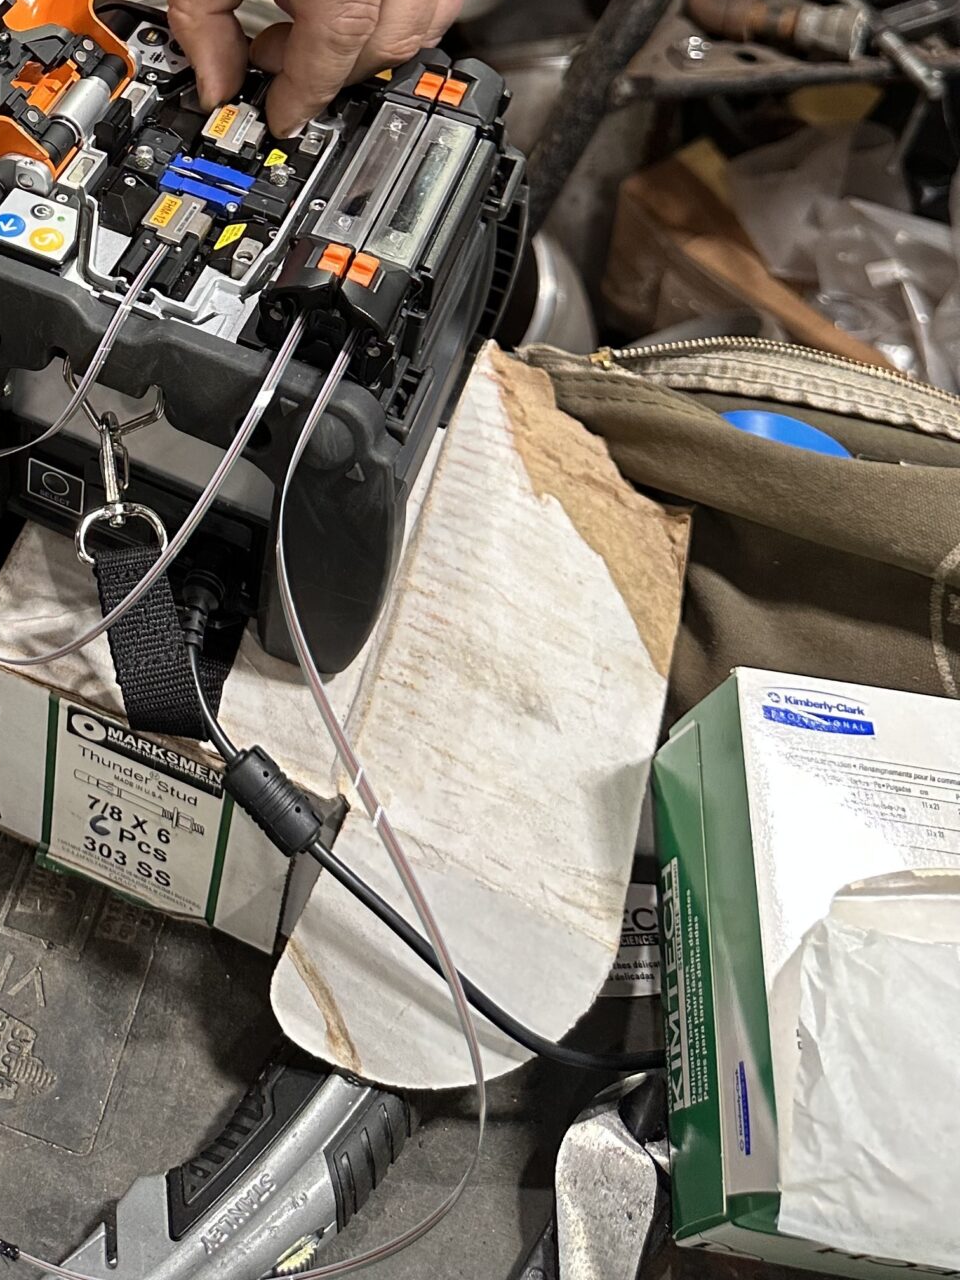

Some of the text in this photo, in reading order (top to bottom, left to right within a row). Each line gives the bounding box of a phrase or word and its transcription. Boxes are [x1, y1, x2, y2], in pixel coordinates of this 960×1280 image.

[771, 709, 866, 731] PROFIONAL
[785, 695, 865, 716] Kimberly-Clark
[79, 745, 200, 806] Thunder Stud
[108, 728, 224, 784] MARKSMEN
[87, 794, 171, 844] 7/8 X 6
[84, 836, 171, 887] 303 SS
[620, 935, 655, 945] CIENCE
[693, 916, 702, 977] delicadas
[662, 863, 683, 1110] KIMTECH
[201, 1173, 274, 1253] STANLEY
